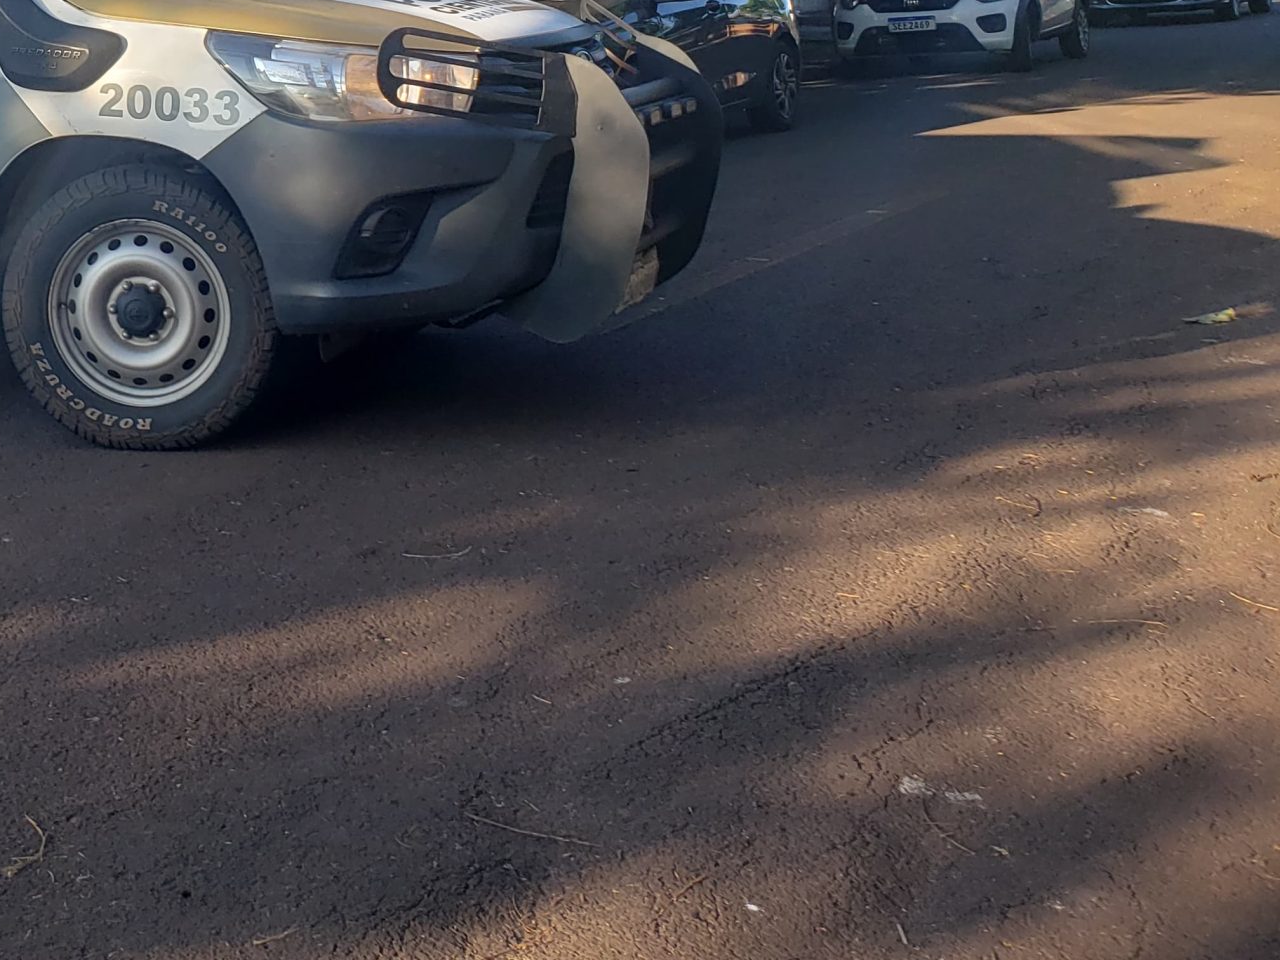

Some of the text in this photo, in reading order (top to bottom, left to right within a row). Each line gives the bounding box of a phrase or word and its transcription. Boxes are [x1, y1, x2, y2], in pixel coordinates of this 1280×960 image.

[99, 83, 241, 126] 20033
[152, 200, 227, 253] RA1100
[30, 342, 152, 430] ROADCRUZA
